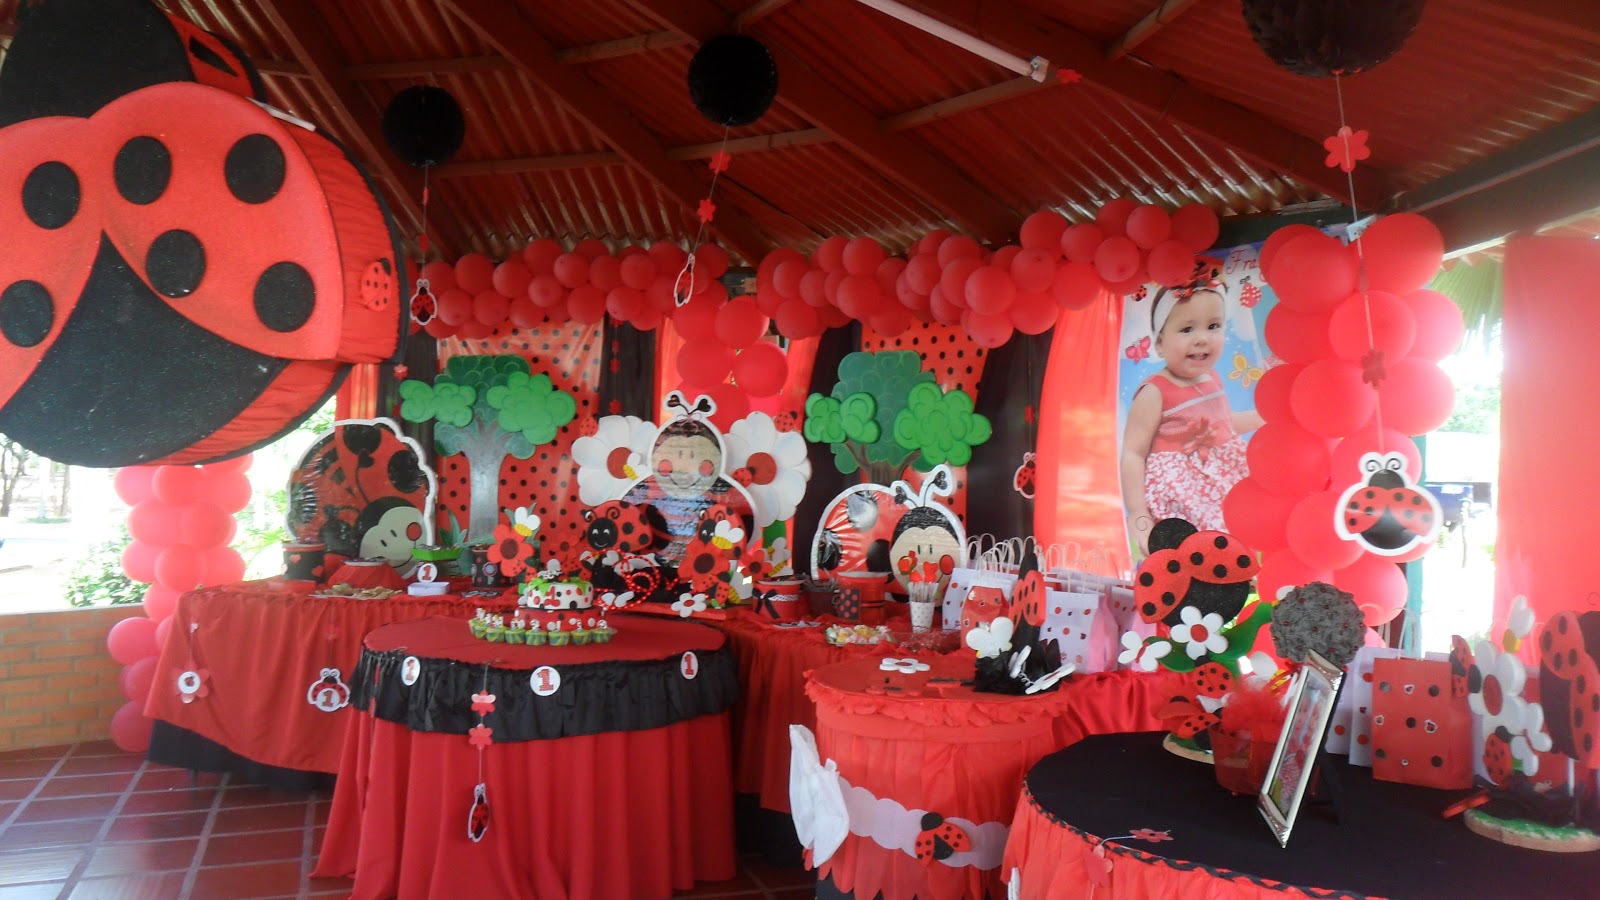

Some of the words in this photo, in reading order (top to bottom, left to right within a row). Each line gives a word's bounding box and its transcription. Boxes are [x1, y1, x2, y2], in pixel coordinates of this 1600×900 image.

[421, 565, 432, 580] 1
[405, 658, 415, 682] 1
[684, 653, 694, 675] 1
[537, 668, 554, 691] 1
[321, 690, 333, 707] 1
